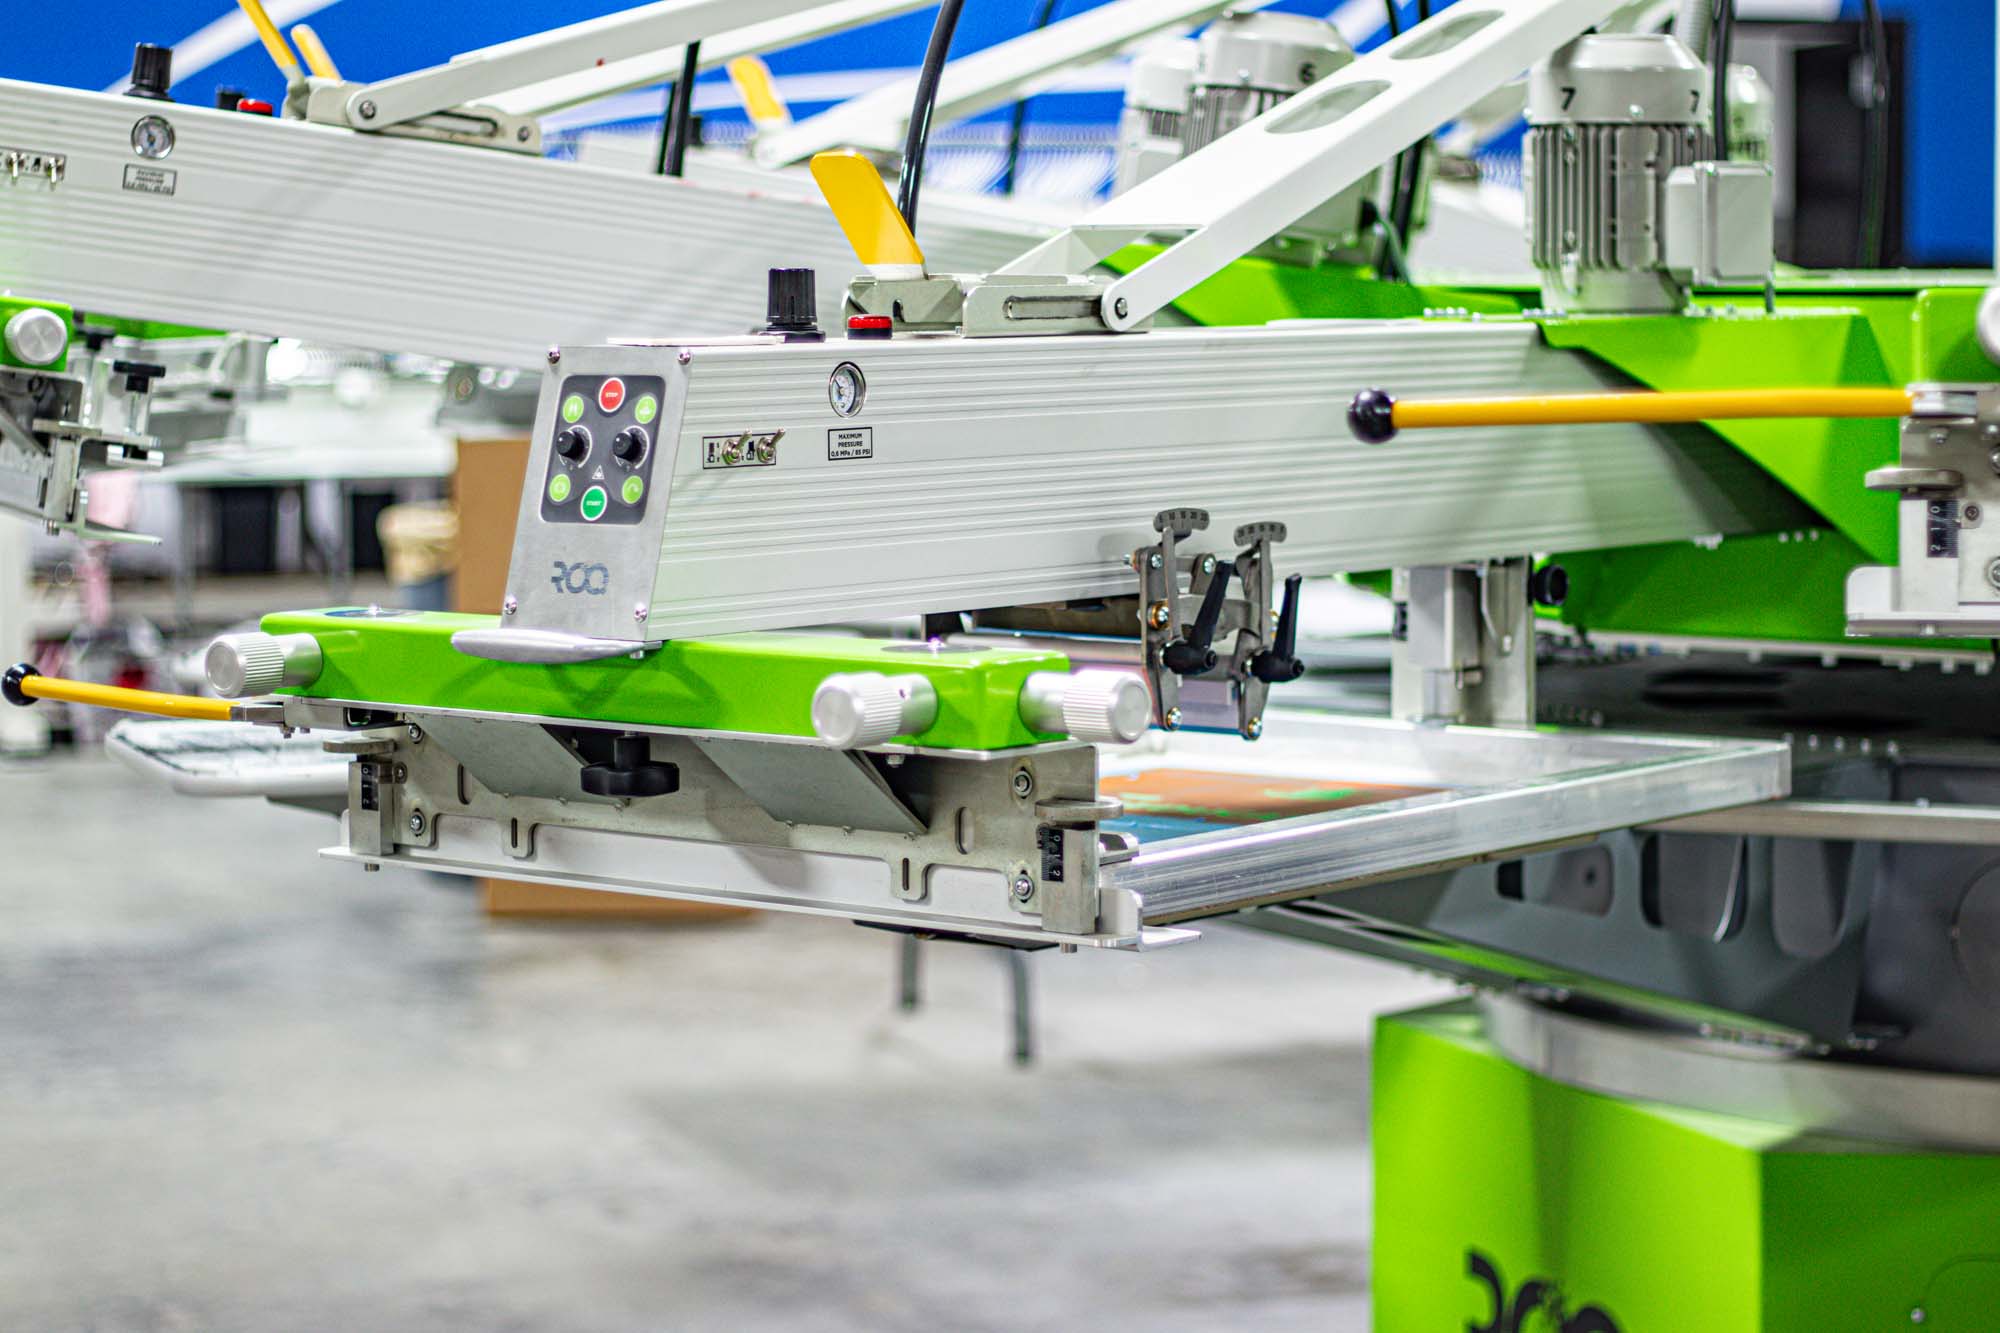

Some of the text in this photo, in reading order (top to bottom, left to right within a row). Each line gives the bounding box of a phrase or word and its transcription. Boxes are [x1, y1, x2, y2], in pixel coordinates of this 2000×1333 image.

[1298, 62, 1315, 85] 6
[1560, 86, 1576, 111] 7
[1689, 89, 1700, 113] 7
[862, 448, 871, 456] PSI
[551, 561, 608, 595] ROQ
